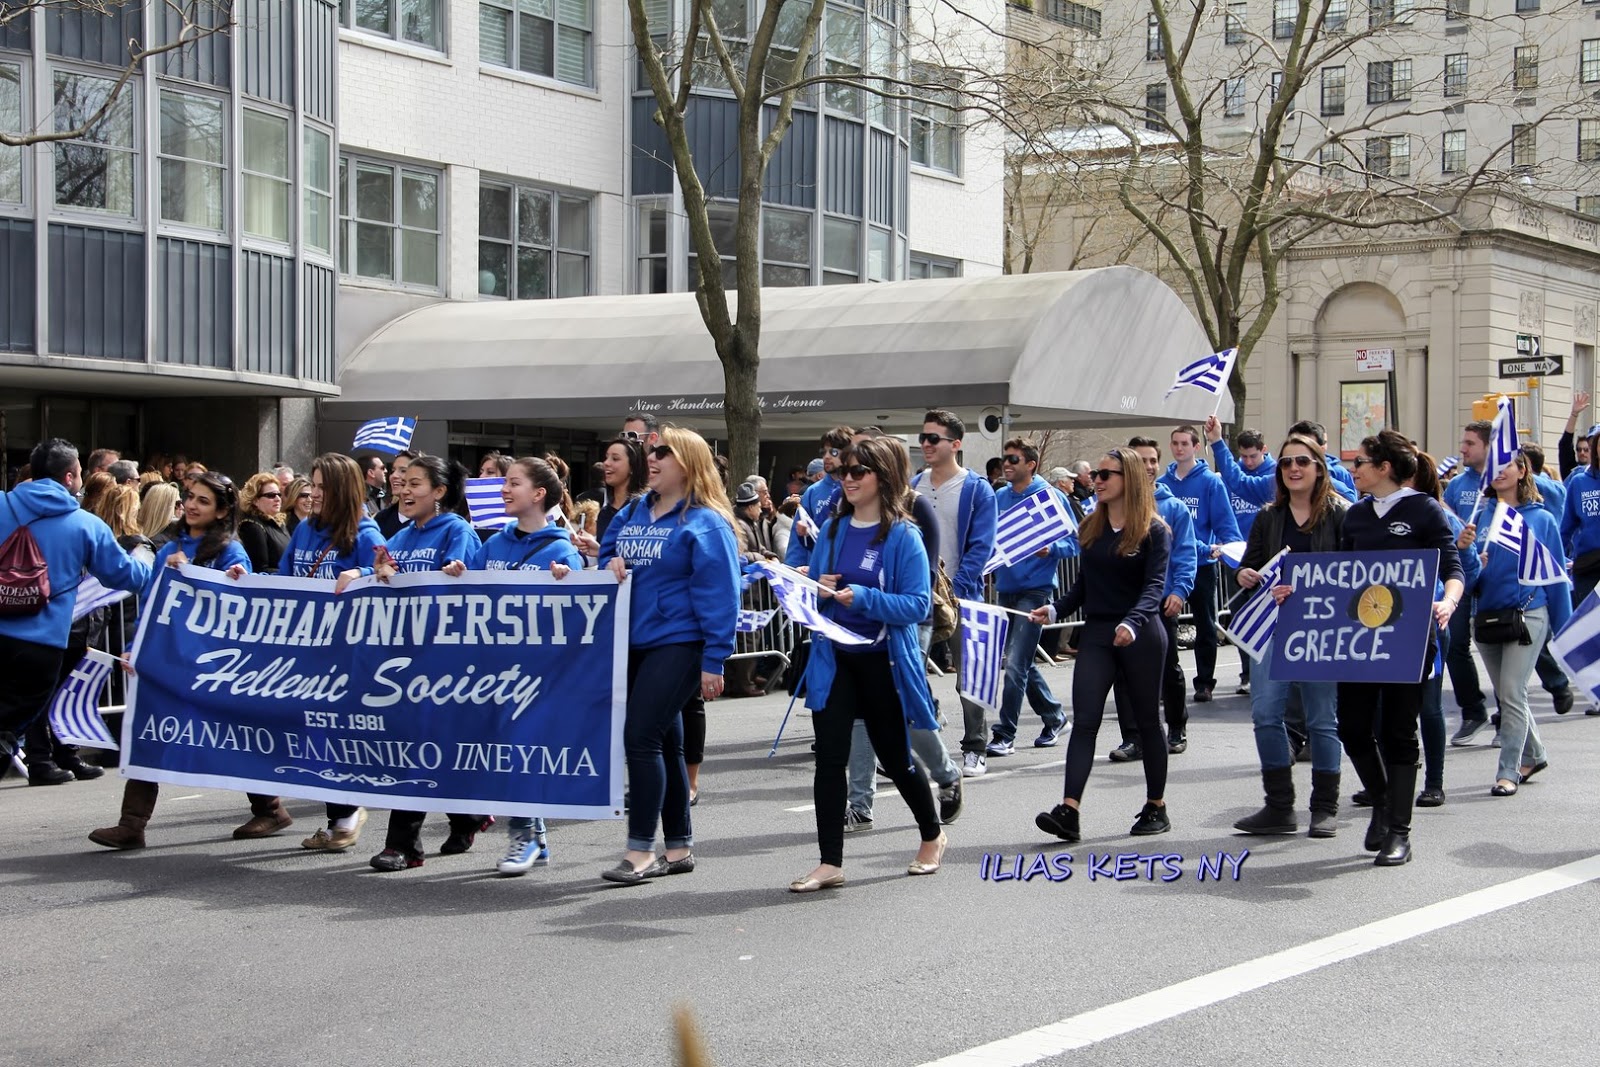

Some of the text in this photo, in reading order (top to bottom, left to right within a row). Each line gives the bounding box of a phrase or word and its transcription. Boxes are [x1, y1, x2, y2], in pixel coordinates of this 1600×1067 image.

[1357, 350, 1367, 360] NO
[1507, 362, 1554, 373] ONE WAY
[629, 398, 662, 412] Nine
[667, 397, 725, 411] Hundred
[773, 394, 826, 408] Avenue
[1120, 396, 1138, 409] 900
[1291, 558, 1427, 594] MACEDONIA
[156, 580, 609, 647] FORDHAM UNIVERSITY
[1302, 595, 1336, 619] IS
[1284, 626, 1395, 663] GREECE
[191, 647, 543, 721] Hellenic Society
[304, 710, 386, 732] EST. 1981
[138, 713, 600, 777] ΑΘΑΝΑΤΟ ΕΛΛΗΝΙΚΟ ΠΝΕΥΜΑ
